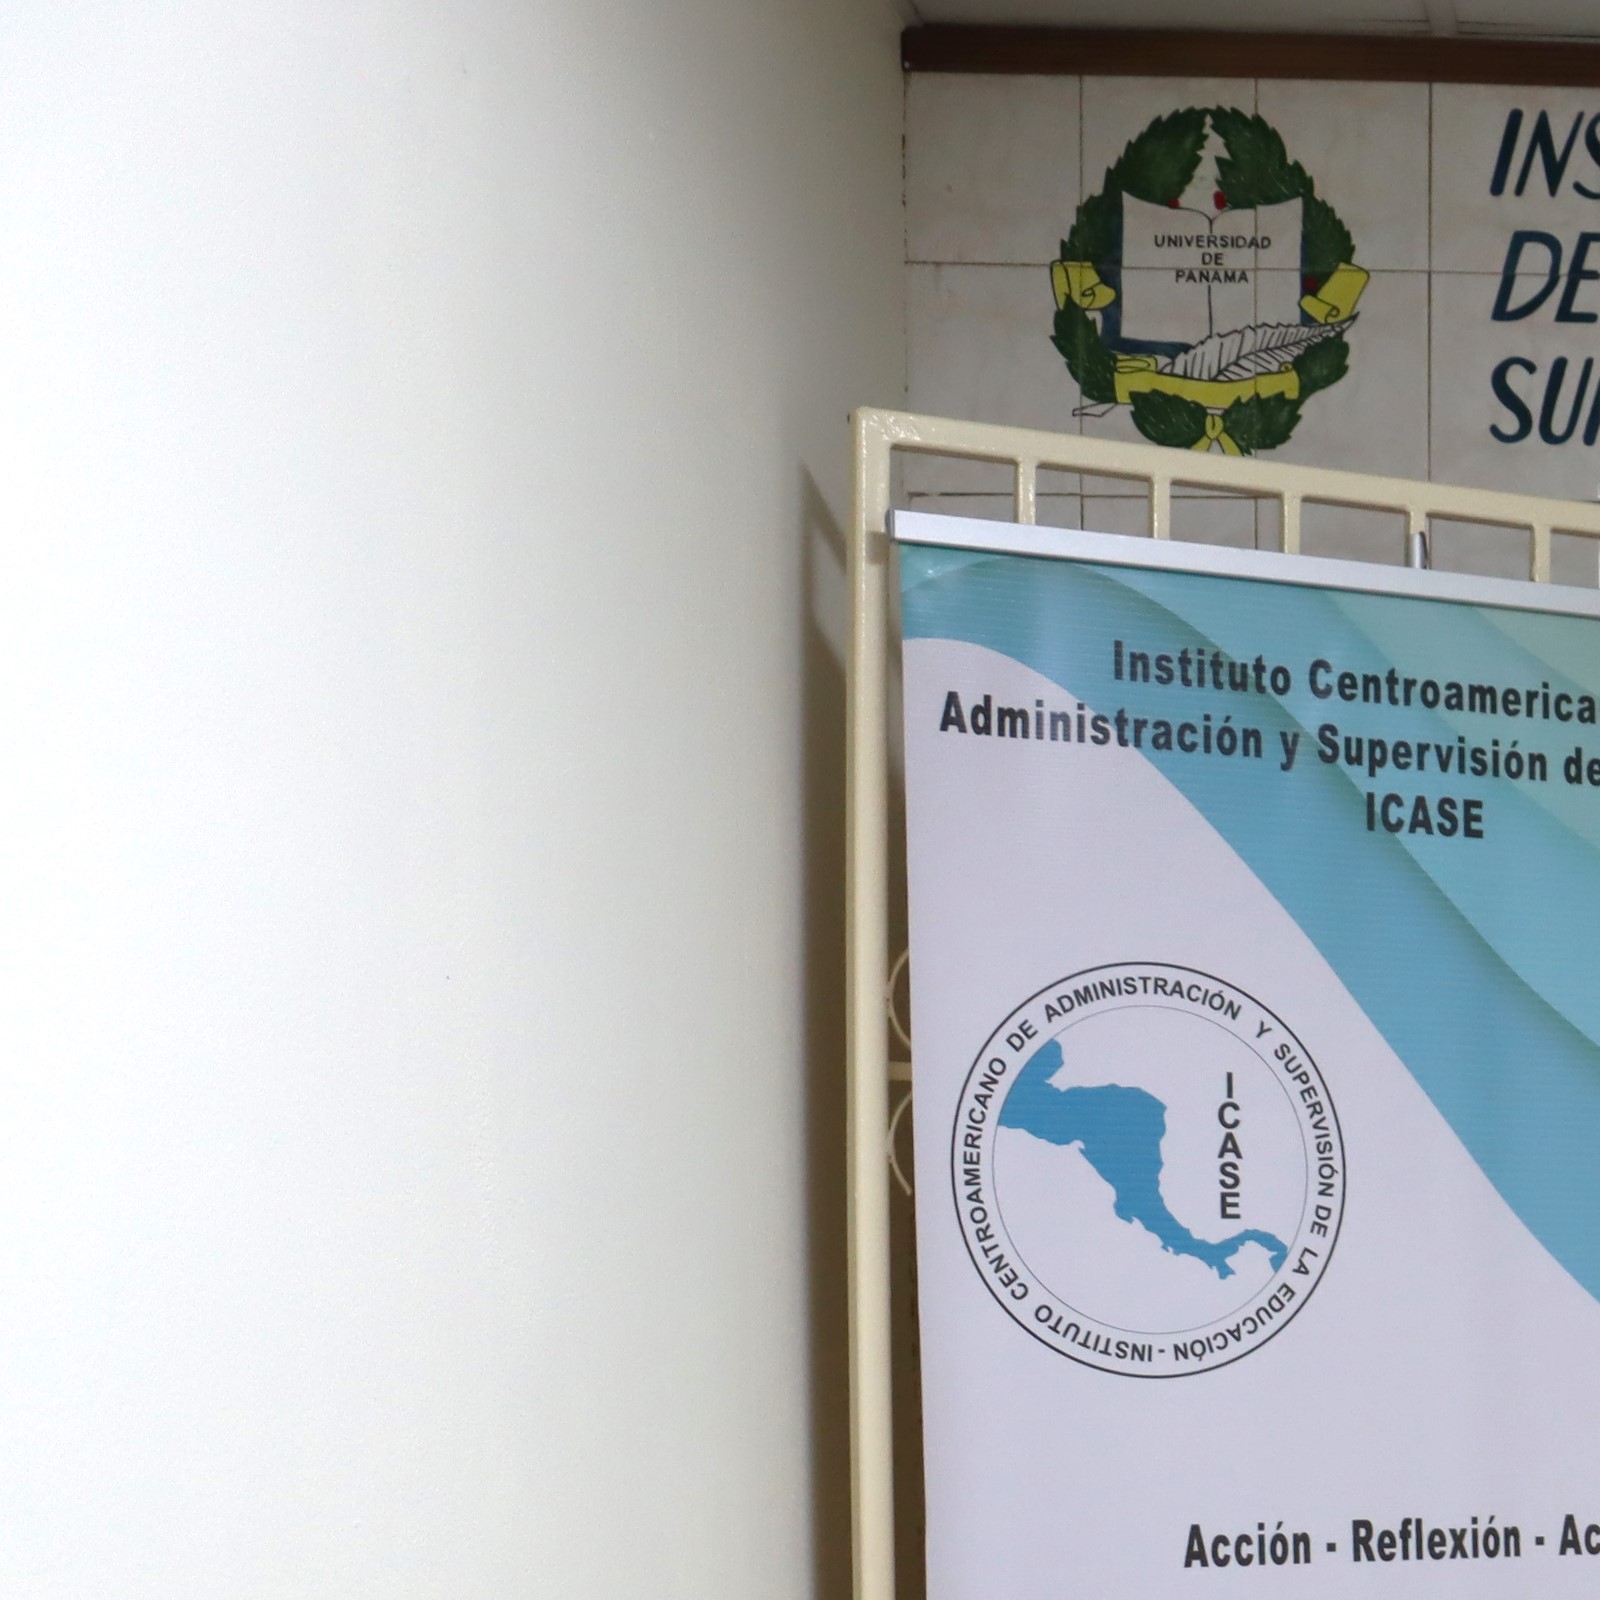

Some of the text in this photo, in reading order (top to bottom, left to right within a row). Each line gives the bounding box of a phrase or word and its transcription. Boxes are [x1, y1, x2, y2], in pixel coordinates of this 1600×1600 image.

[1154, 234, 1271, 249] UNIVERSIDAD
[1202, 252, 1224, 266] DE
[1175, 269, 1249, 284] PANAMA
[1112, 639, 1292, 698] Instituto
[938, 690, 1264, 760] Administración
[1278, 726, 1301, 772] y
[1316, 722, 1549, 785] Supervisión
[1364, 792, 1486, 842] ICASE
[1042, 976, 1243, 1024] ADMINISTRACIÓN
[1006, 1019, 1039, 1054] DE
[1254, 1019, 1273, 1040] Y
[1217, 1071, 1243, 1220] ICASE
[1273, 1042, 1340, 1199] SUPERVISIÓN
[963, 1056, 1031, 1301] CENTROAMERICANO
[1309, 1203, 1332, 1239] DE
[1291, 1246, 1320, 1278] LA
[1033, 1303, 1154, 1363] INSTITUTO
[1173, 1282, 1297, 1363] EDUCACIÓN
[1183, 1521, 1311, 1569] Acción
[1351, 1516, 1521, 1564] Reflexión
